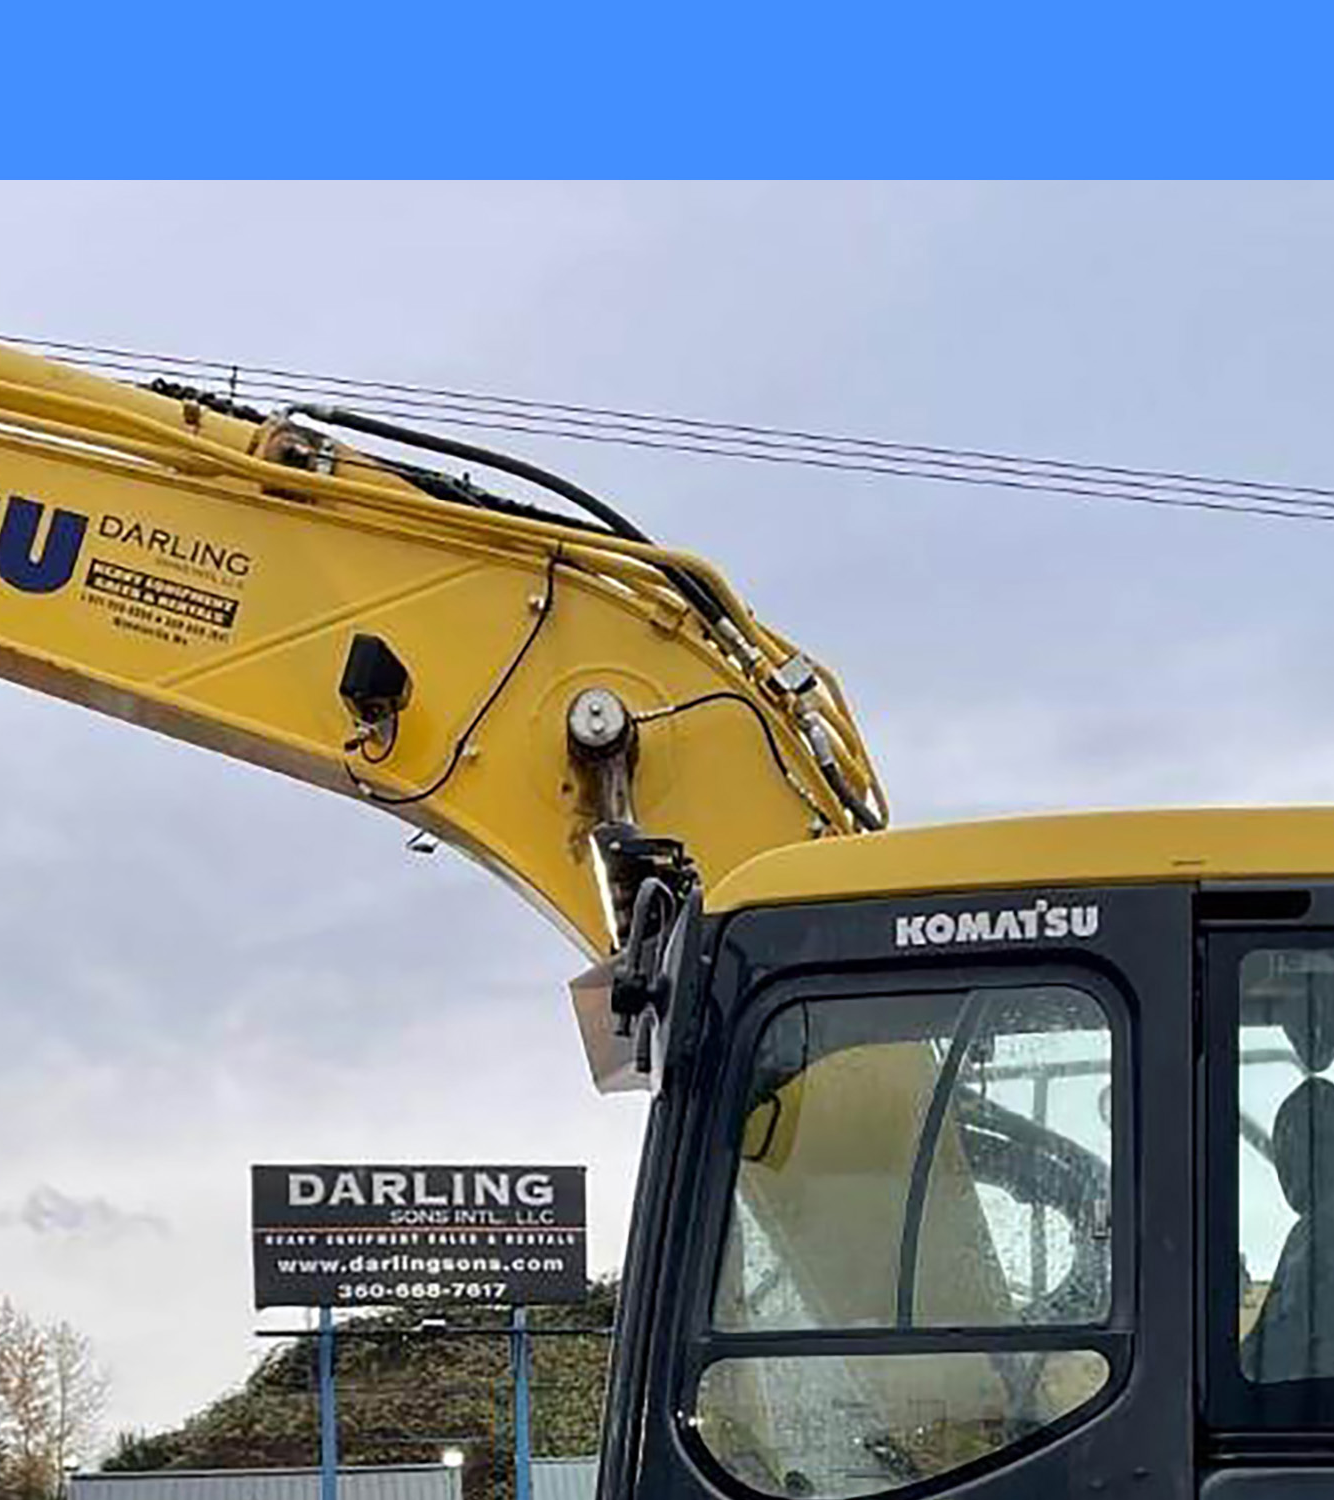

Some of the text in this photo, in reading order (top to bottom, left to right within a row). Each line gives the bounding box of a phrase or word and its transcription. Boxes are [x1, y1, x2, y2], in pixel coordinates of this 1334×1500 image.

[99, 515, 250, 577] DARLING
[896, 900, 1098, 946] KOMATSU
[288, 1172, 554, 1206] DARLING
[389, 1209, 449, 1224] SONS
[516, 1210, 555, 1225] LLC
[265, 1234, 316, 1245] HEAVY
[326, 1233, 418, 1245] EQUIPMENT
[428, 1233, 477, 1245] SALES
[277, 1254, 564, 1275] www.darlingsons.com
